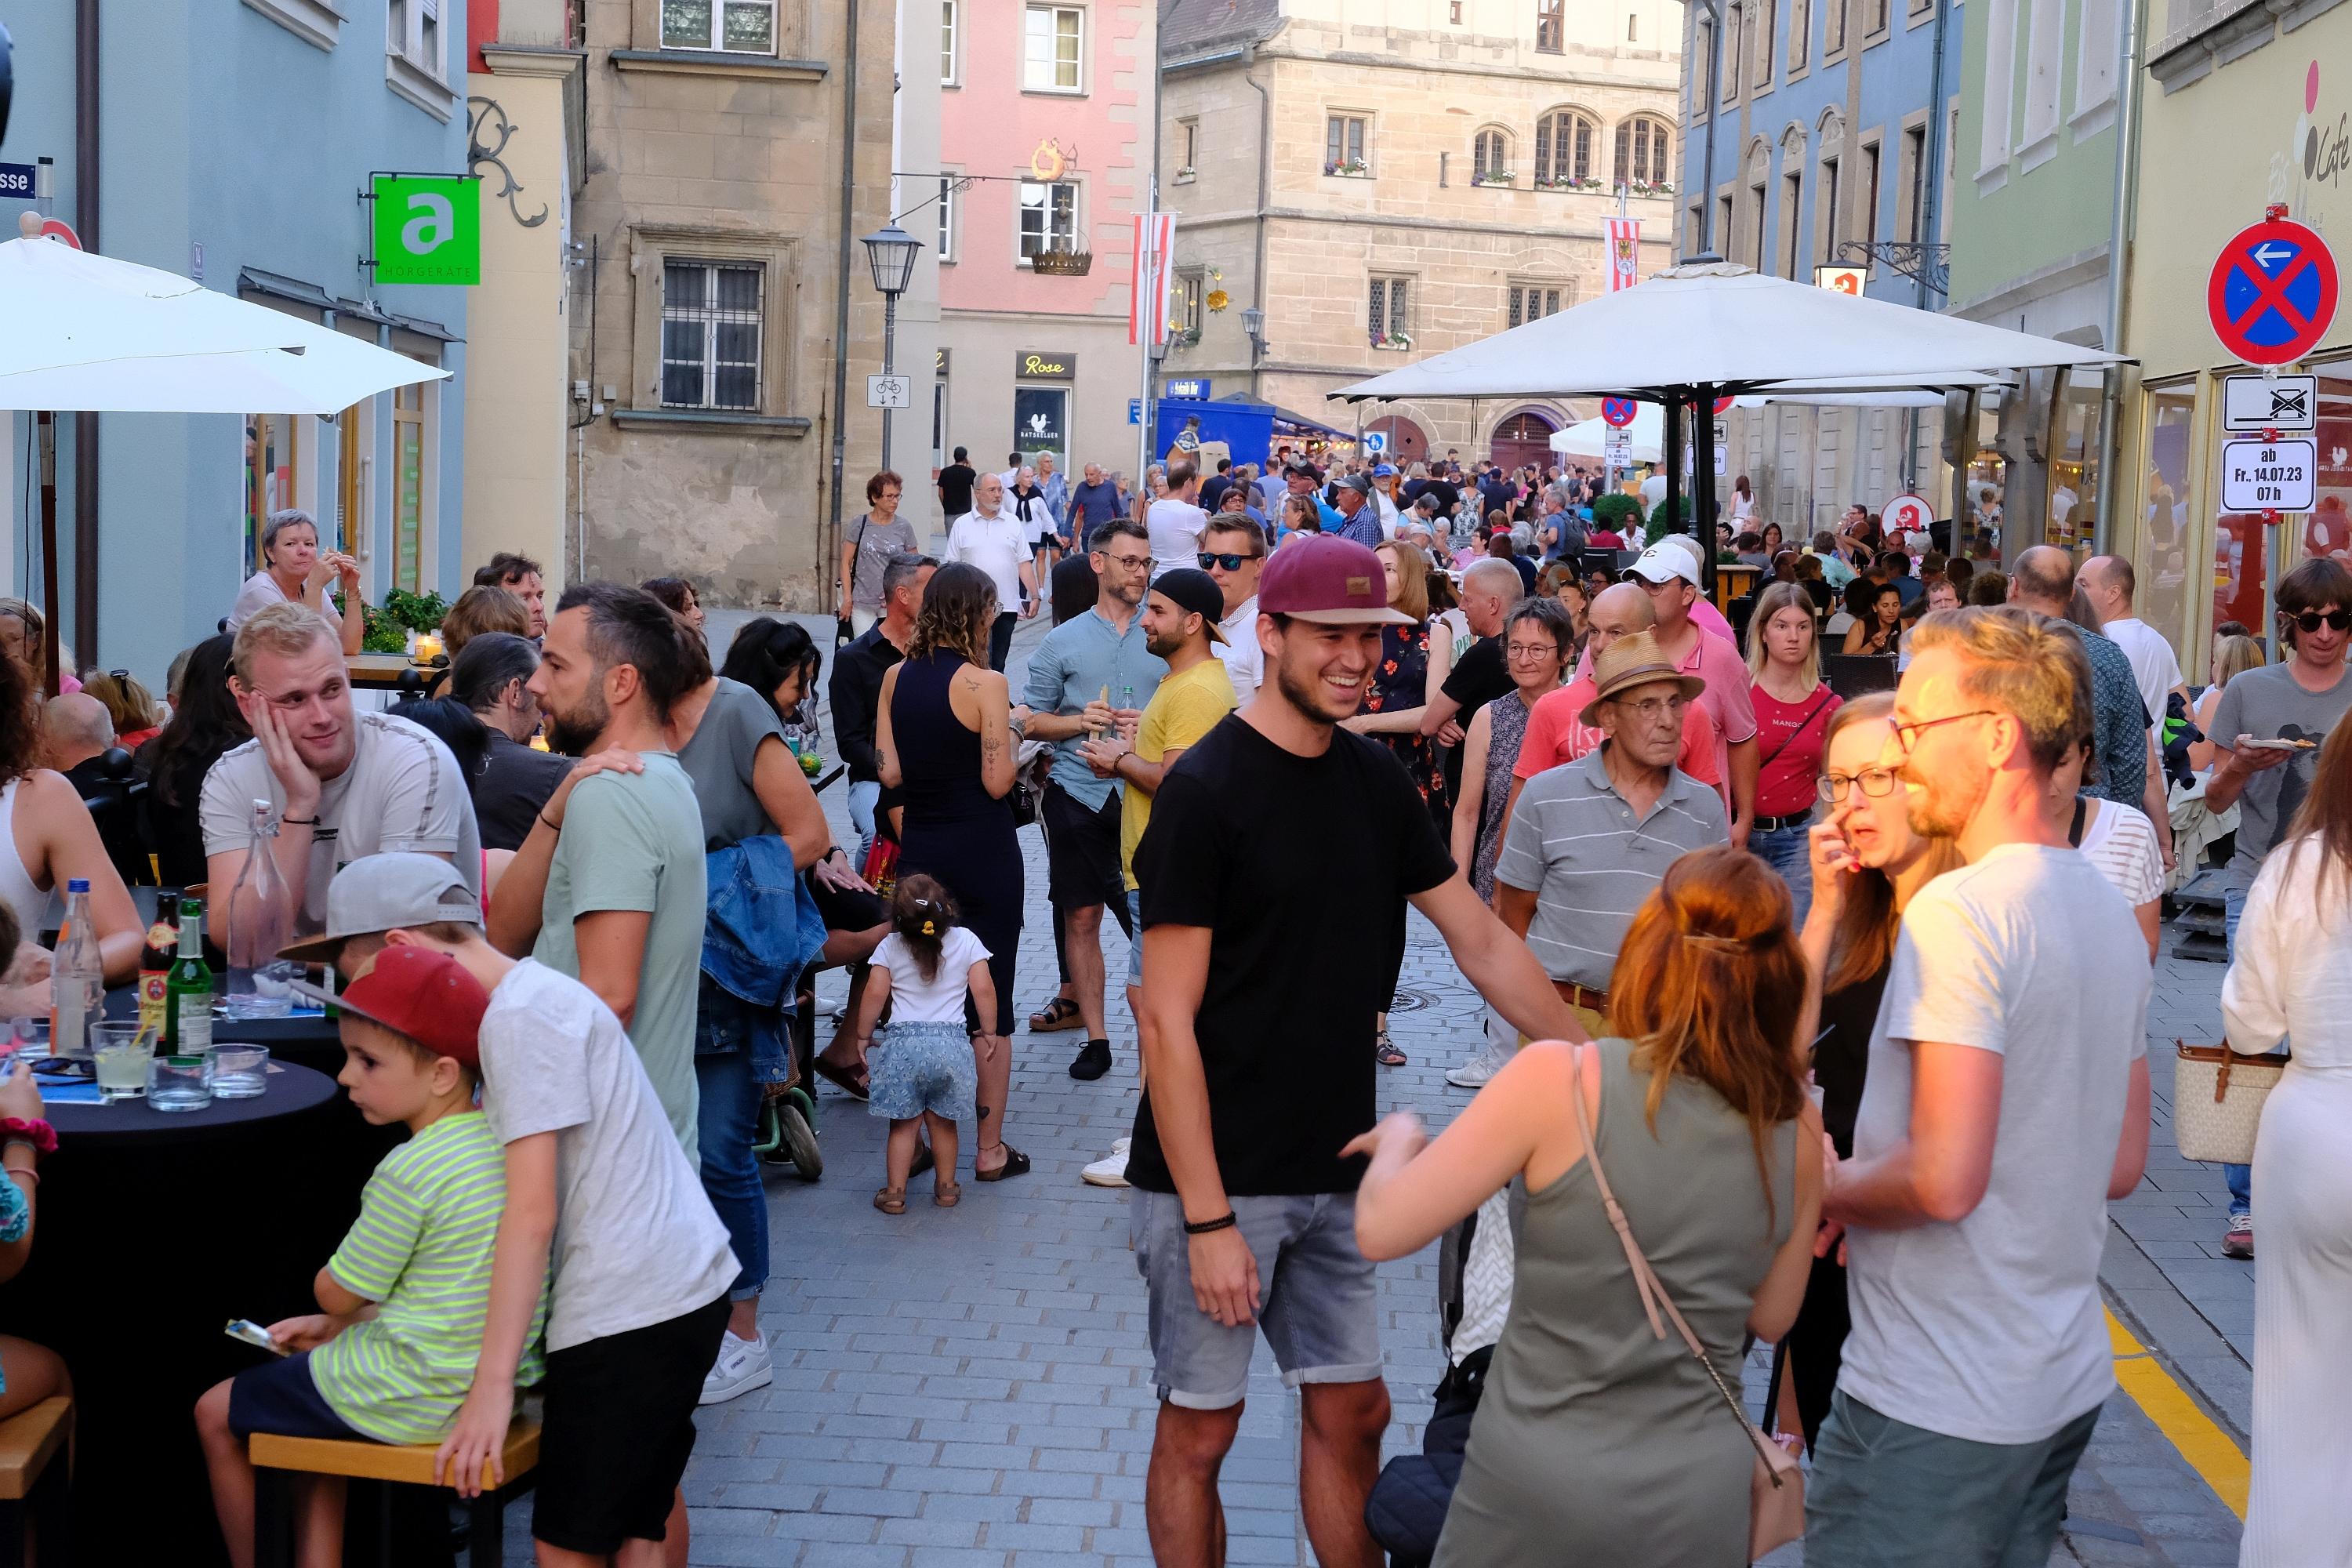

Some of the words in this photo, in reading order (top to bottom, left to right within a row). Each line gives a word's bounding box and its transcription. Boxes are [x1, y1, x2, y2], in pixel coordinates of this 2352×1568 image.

[2317, 112, 2350, 190] Cafe
[0, 173, 28, 190] sse
[401, 192, 454, 256] a
[385, 266, 470, 278] HÖRGERÄTE
[1025, 355, 1065, 374] Rose
[2261, 448, 2276, 463] ab
[2235, 468, 2252, 482] Fr.,
[2254, 467, 2302, 481] 14.07.23
[2257, 487, 2270, 501] 07
[2274, 487, 2281, 501] h
